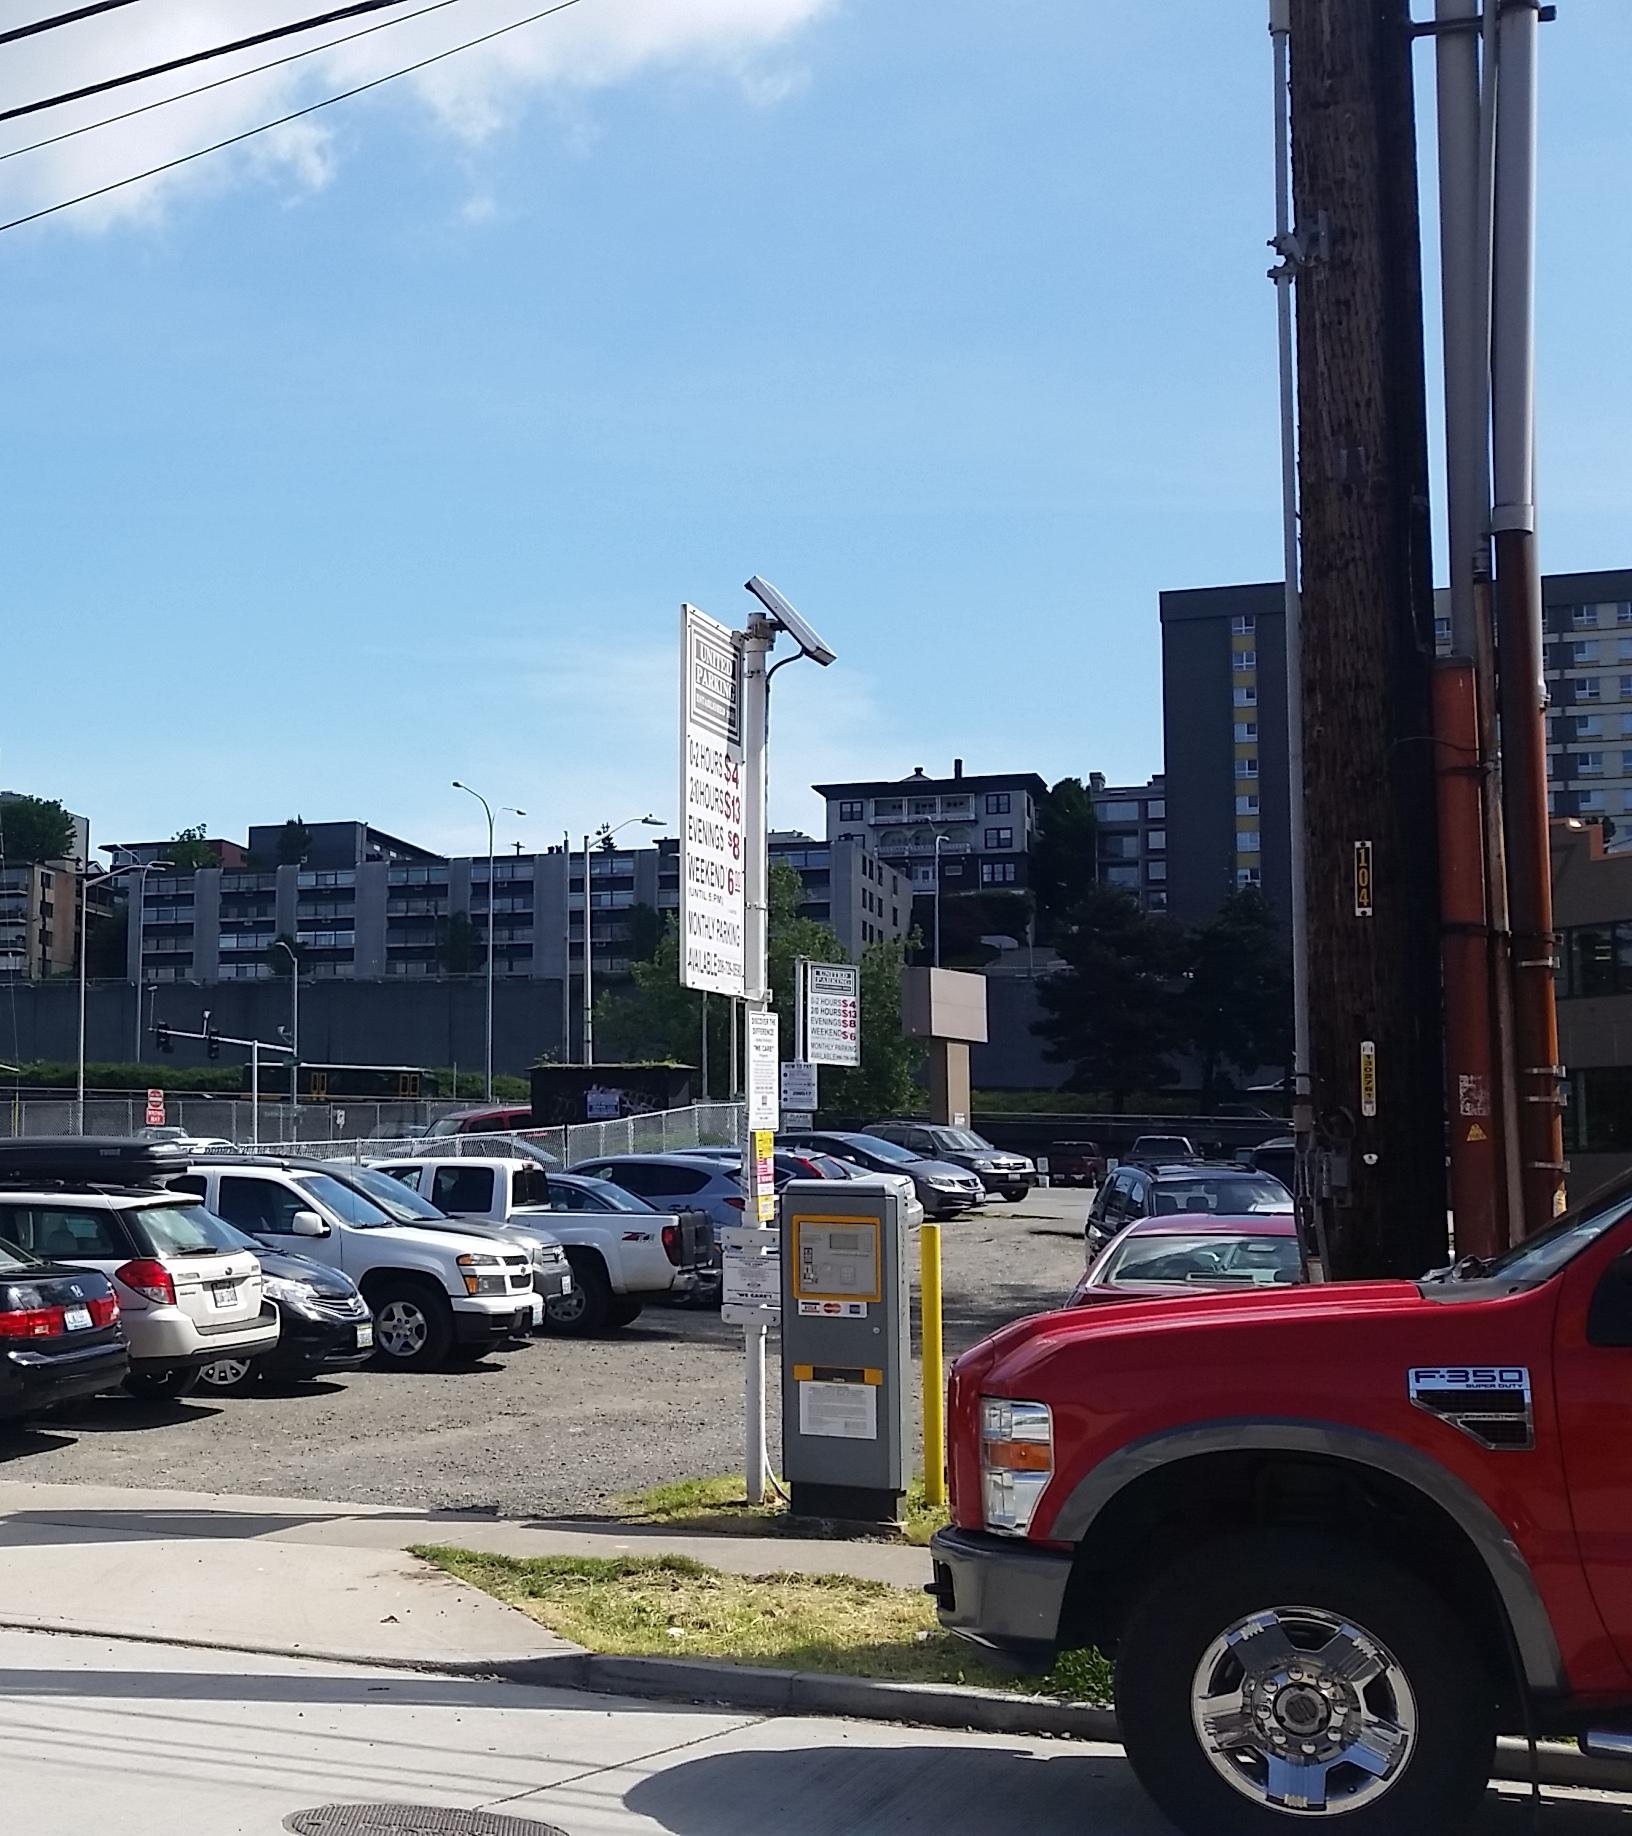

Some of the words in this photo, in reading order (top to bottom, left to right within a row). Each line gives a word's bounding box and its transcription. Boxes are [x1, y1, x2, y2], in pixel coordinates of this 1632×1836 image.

[699, 643, 733, 677] UNITED
[696, 664, 737, 703] PARKING
[701, 744, 723, 778] HOURS
[724, 753, 739, 790] $4
[700, 781, 724, 815] HOURS
[724, 791, 740, 825] $13
[688, 815, 724, 851] EVENINGS
[728, 830, 740, 860] $8
[688, 855, 725, 889] WEEKEND
[1359, 848, 1369, 906] 104
[688, 910, 715, 940] MONTHLY
[716, 918, 740, 947] PARKING
[821, 998, 841, 1007] HOURS
[841, 999, 856, 1008] $4
[821, 1007, 841, 1016] HOURS
[841, 1009, 857, 1018] $13
[811, 1017, 841, 1027] EVENINGS
[841, 1019, 856, 1028] $8
[811, 1027, 841, 1037] WEEKEND
[841, 1031, 856, 1041] $6
